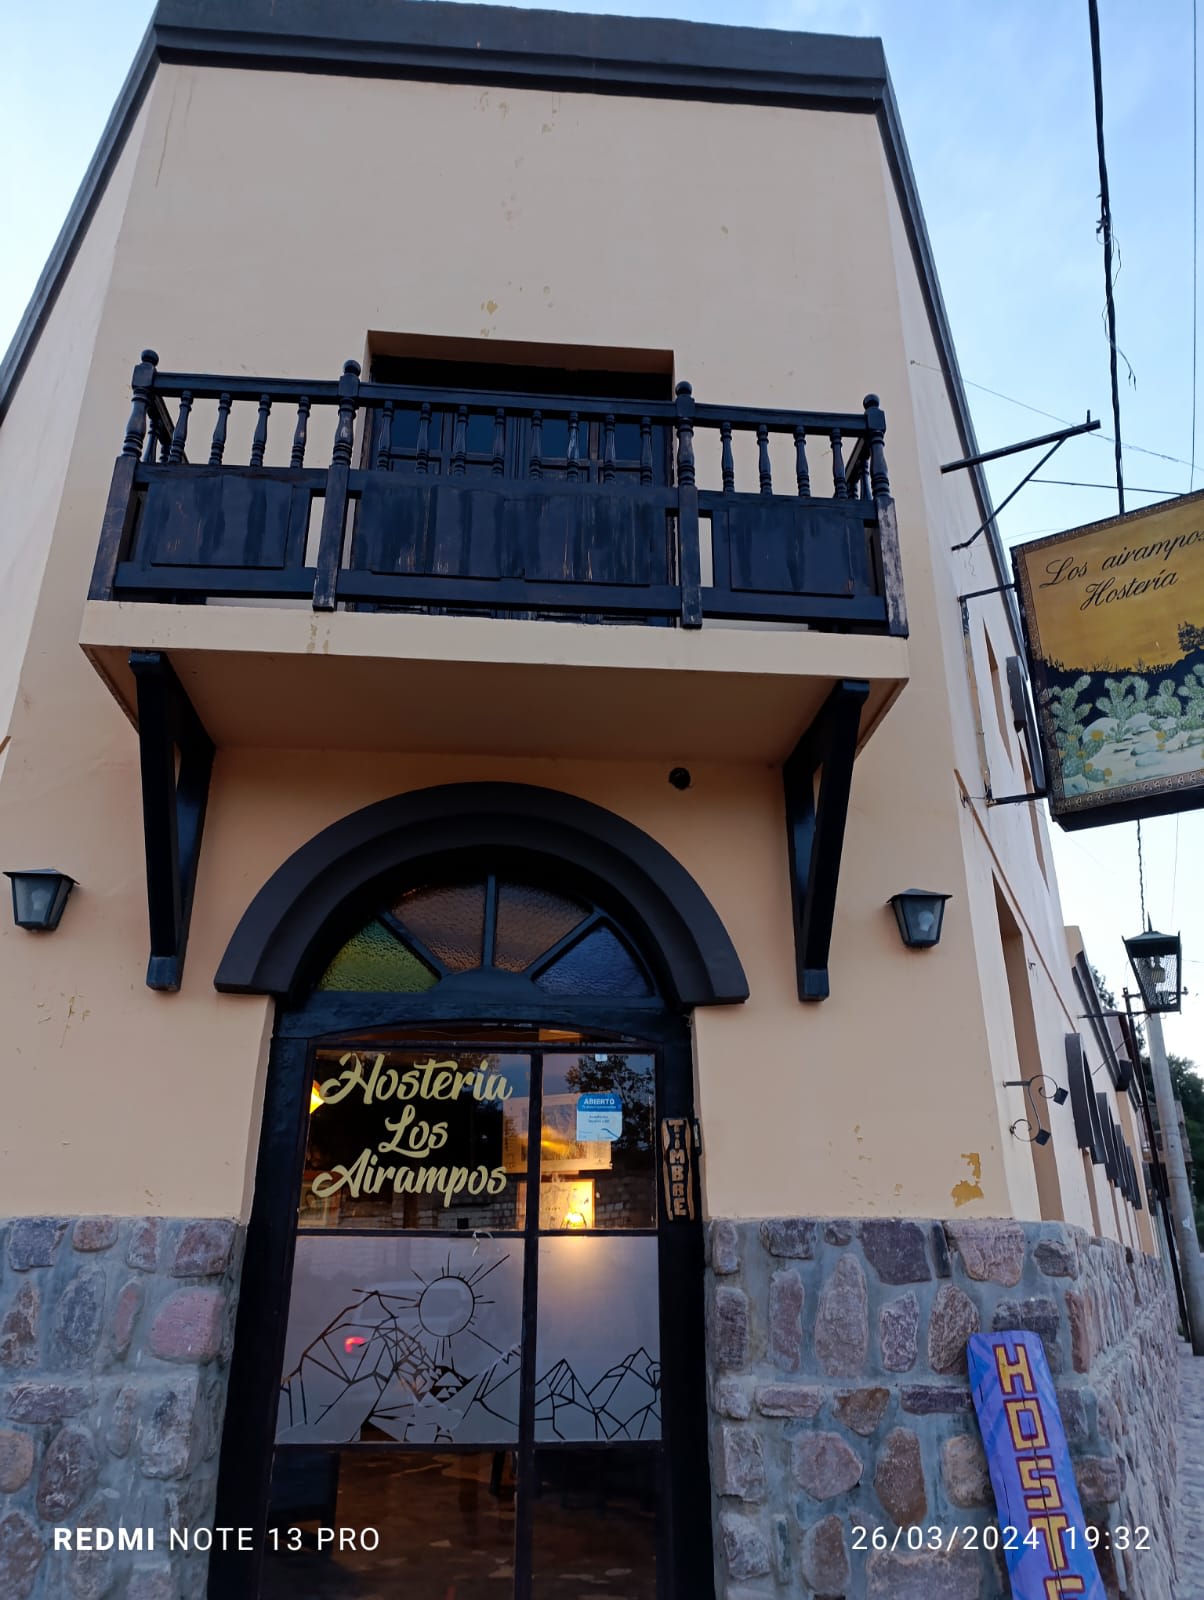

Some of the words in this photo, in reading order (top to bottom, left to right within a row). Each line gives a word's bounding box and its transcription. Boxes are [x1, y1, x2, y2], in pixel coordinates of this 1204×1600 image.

[1039, 556, 1088, 588] Los
[1079, 569, 1179, 611] Hostería
[319, 1052, 513, 1105] Hosteria
[377, 1104, 449, 1159] Los
[311, 1148, 508, 1208] Airampos
[667, 1119, 687, 1216] TIMBRE
